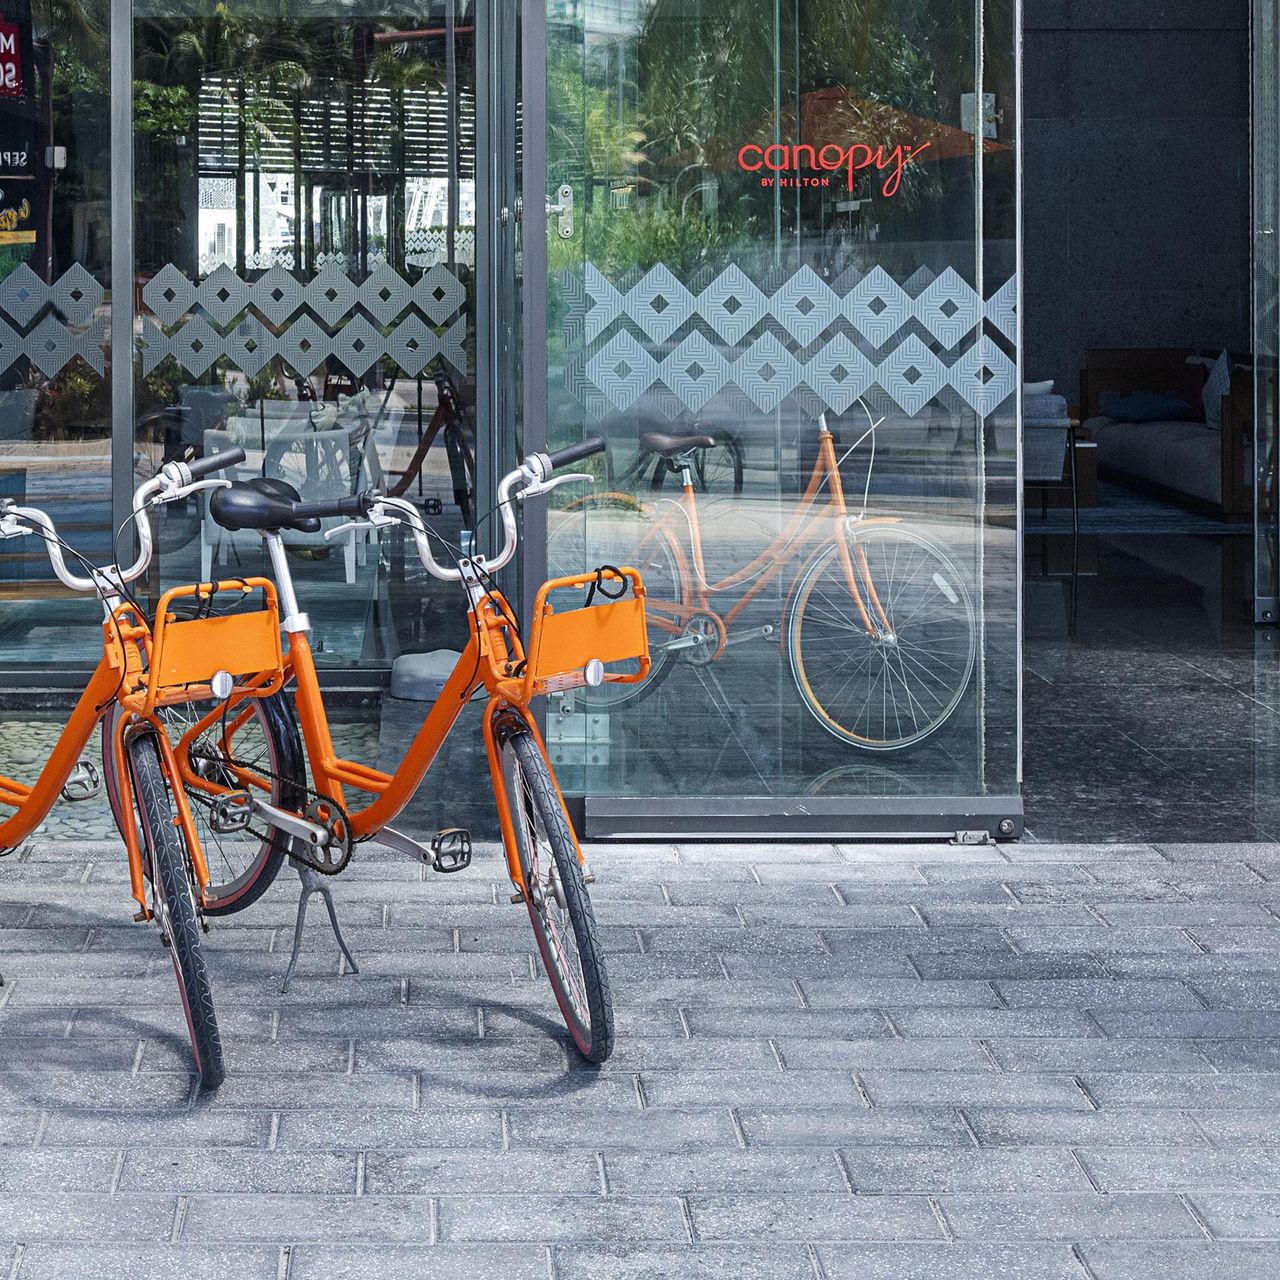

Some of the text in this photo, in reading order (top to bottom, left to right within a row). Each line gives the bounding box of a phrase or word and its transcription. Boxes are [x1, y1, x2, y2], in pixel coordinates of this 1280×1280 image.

[737, 141, 932, 198] canopy
[761, 177, 830, 188] BY HILTON
